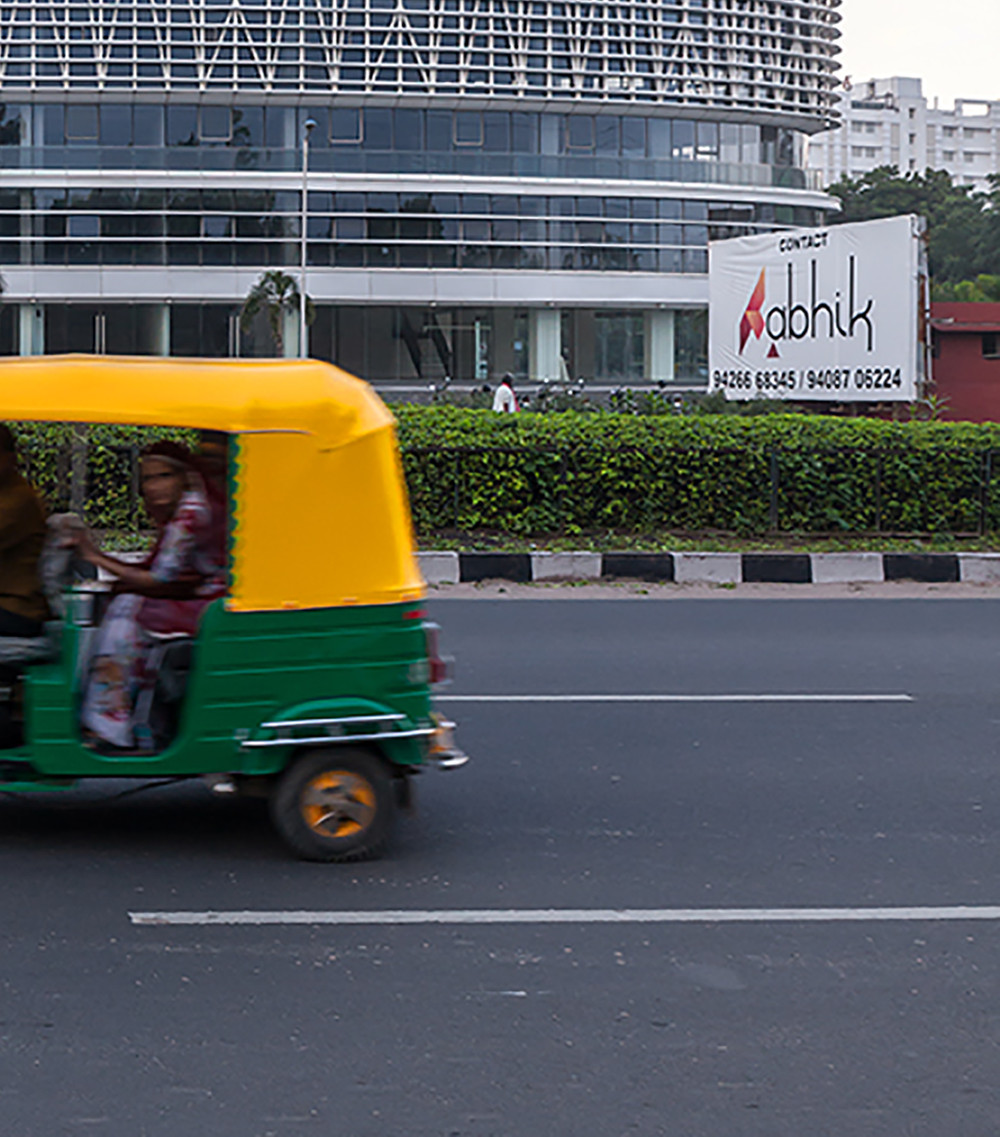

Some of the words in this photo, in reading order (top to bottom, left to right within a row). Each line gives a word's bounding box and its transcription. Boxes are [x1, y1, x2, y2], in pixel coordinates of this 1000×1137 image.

[779, 233, 828, 252] CONTACT
[713, 370, 751, 389] 94266
[755, 370, 796, 389] 68345
[807, 370, 850, 389] 94087
[854, 369, 901, 389] 06224
